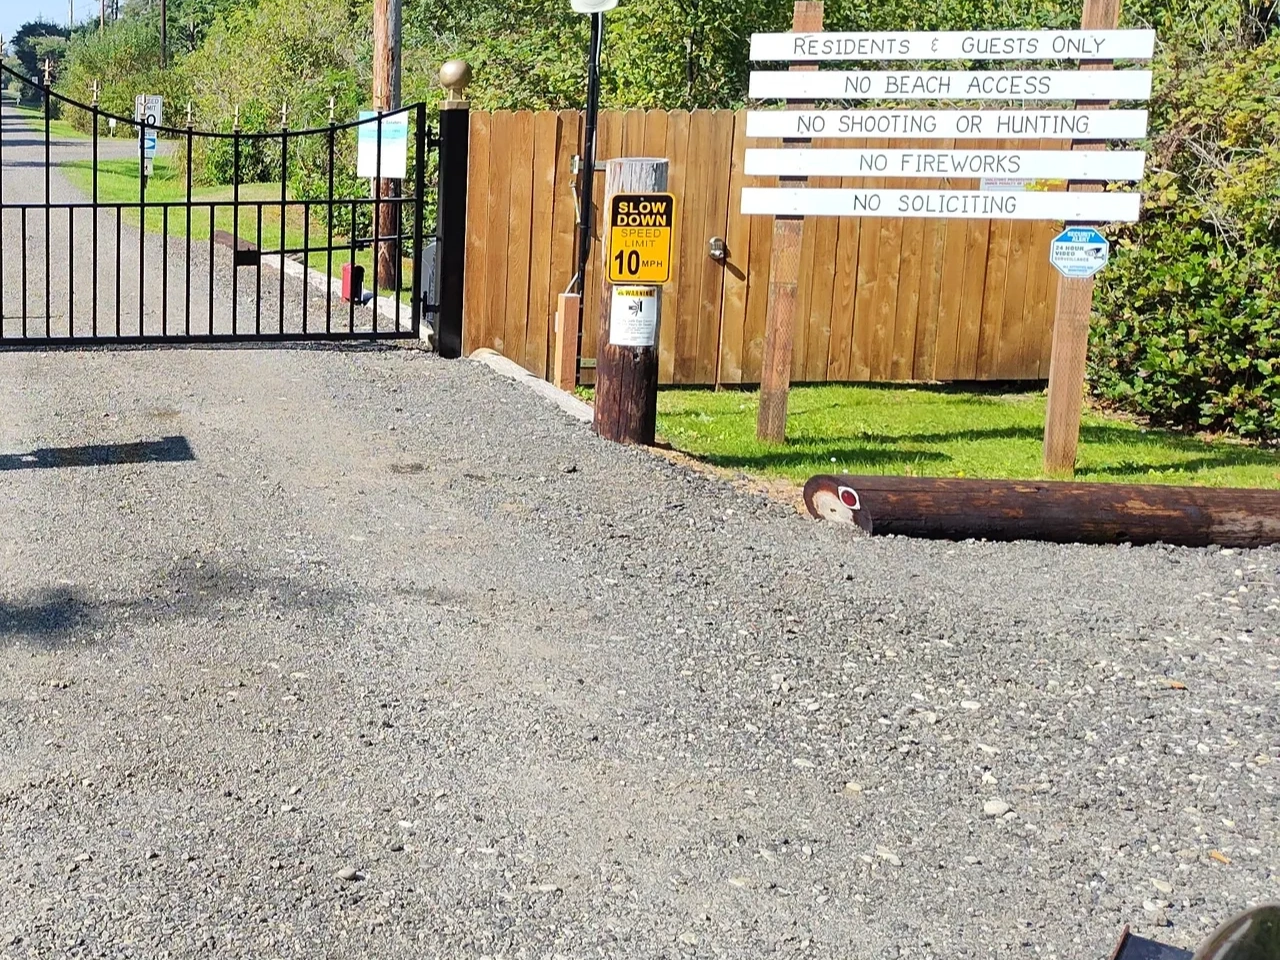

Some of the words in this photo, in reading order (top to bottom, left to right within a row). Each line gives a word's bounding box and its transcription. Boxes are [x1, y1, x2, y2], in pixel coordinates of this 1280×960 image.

[793, 36, 911, 56] RESIDENTS
[961, 36, 1039, 54] GUESTS
[1052, 35, 1106, 54] ONLY
[844, 75, 871, 94] NO
[884, 75, 951, 94] BEACH
[966, 75, 1052, 95] ACCESS
[796, 115, 826, 133] NO
[838, 114, 937, 134] SHOOTING
[956, 115, 983, 134] OR
[996, 114, 1090, 134] HUNTING
[859, 153, 888, 172] NO
[901, 153, 1021, 174] FIREWORKS
[618, 201, 667, 214] SLOW
[853, 193, 882, 212] NO
[898, 194, 1017, 214] SOLICITING
[616, 214, 667, 226] DOWN
[620, 228, 662, 238] SPEED
[624, 239, 656, 248] LIMIT
[614, 249, 641, 276] 10
[641, 260, 663, 268] MPH
[625, 289, 654, 297] WARNING
